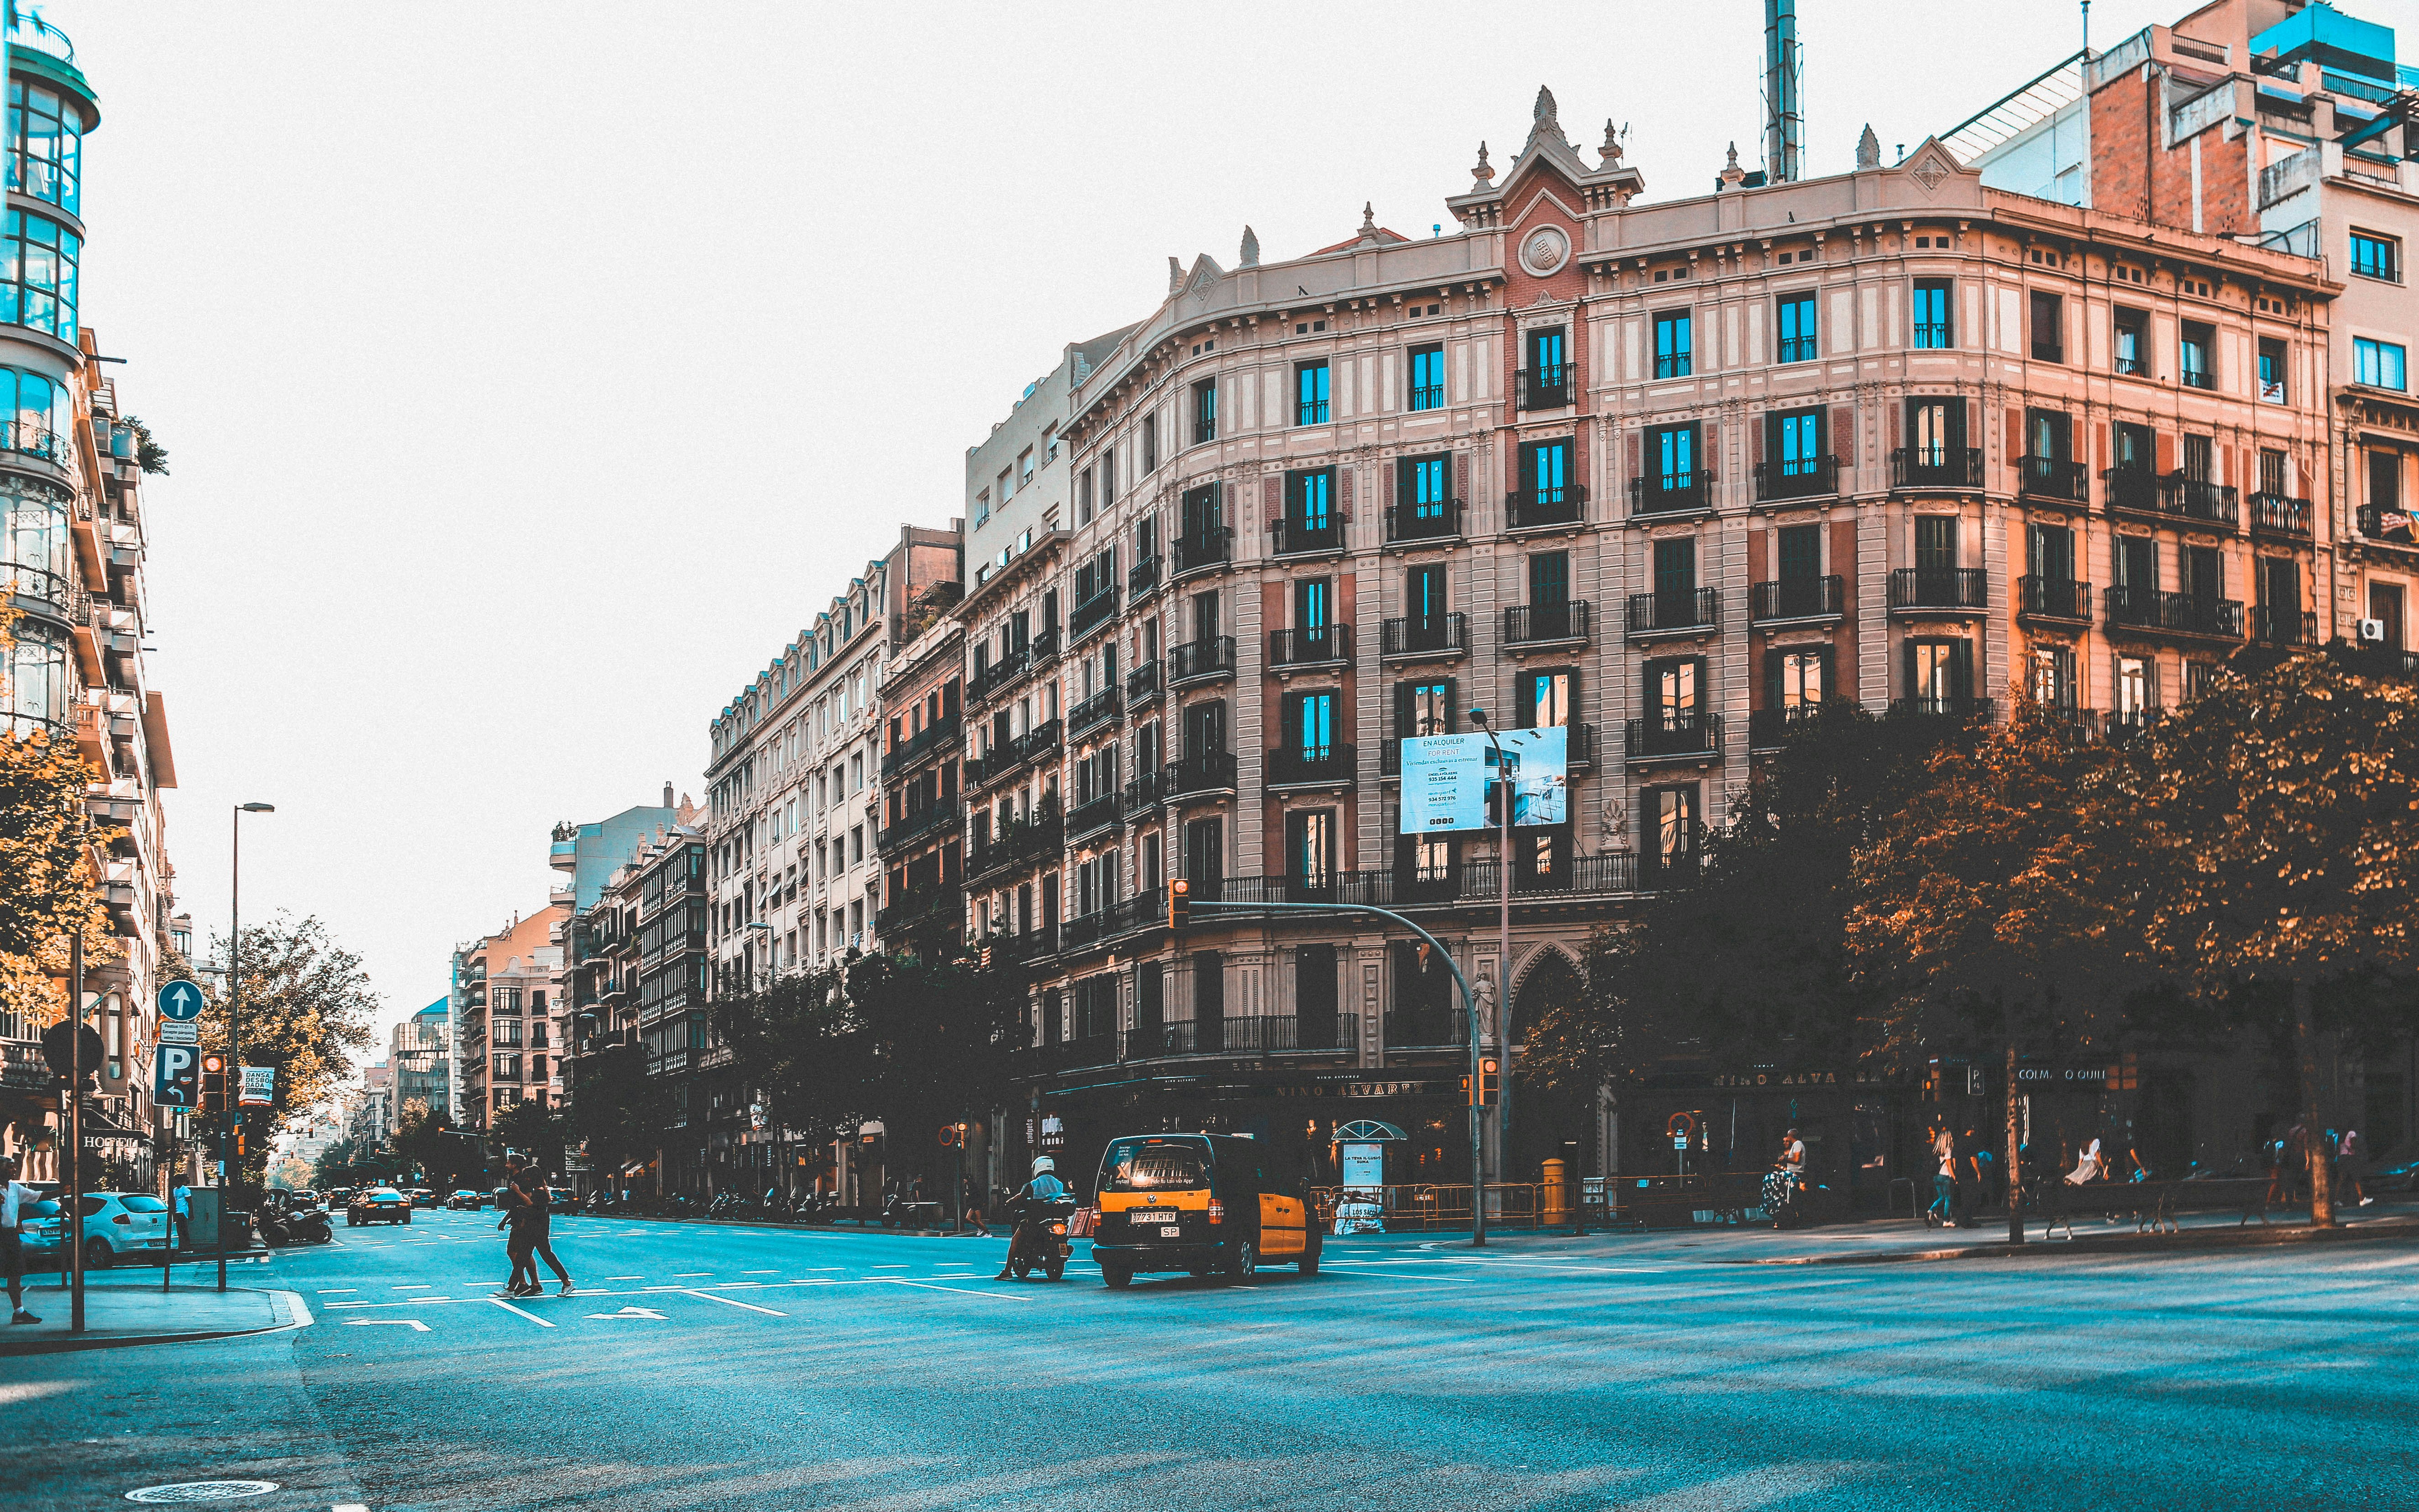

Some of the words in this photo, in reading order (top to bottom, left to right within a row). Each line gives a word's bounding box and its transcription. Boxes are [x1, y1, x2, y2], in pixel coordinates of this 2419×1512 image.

[1534, 238, 1553, 262] 1888
[164, 1048, 191, 1080] P
[1973, 1070, 1979, 1080] P
[1278, 1087, 1322, 1096] NINO
[1338, 1083, 1423, 1096] ALVAREZ
[1026, 1119, 1034, 1143] gadgets
[84, 1136, 138, 1147] HOTEL
[1137, 1213, 1155, 1221] 7731
